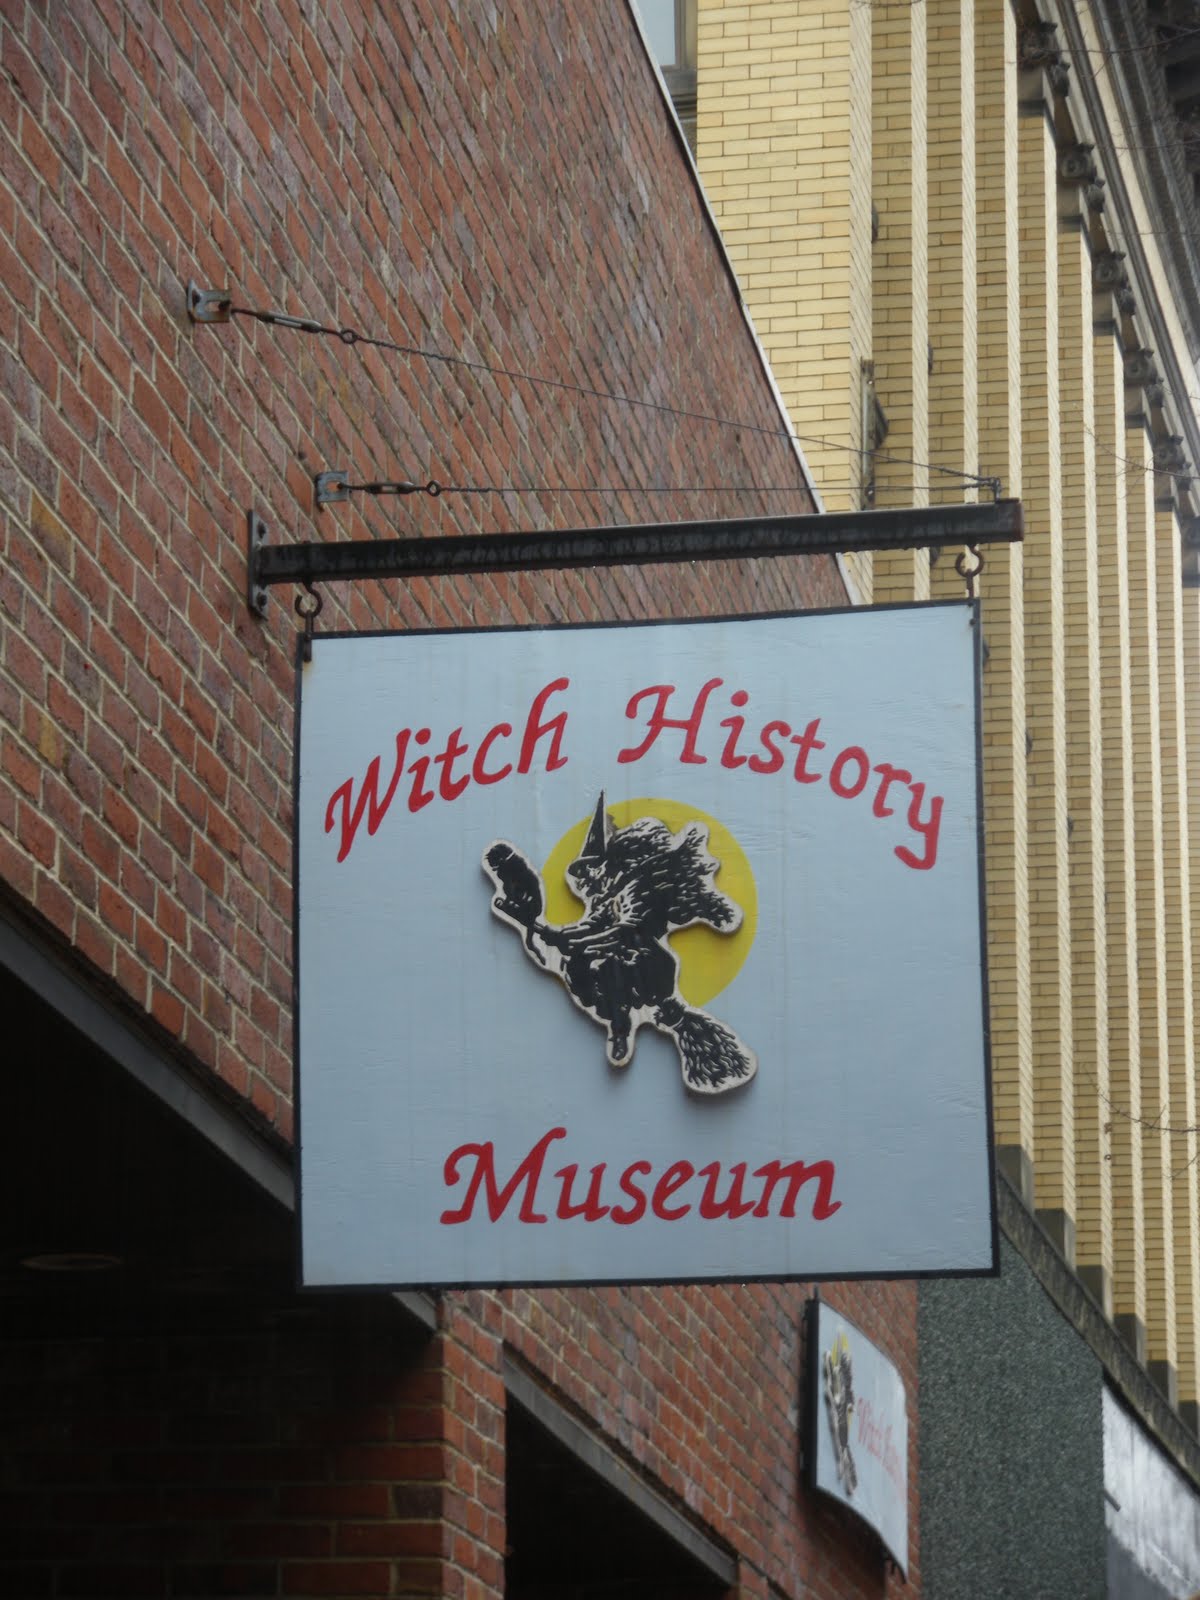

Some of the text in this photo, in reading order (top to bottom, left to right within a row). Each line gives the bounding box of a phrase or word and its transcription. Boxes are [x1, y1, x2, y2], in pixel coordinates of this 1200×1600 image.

[325, 679, 943, 869] Witch History
[441, 1128, 840, 1225] Museum
